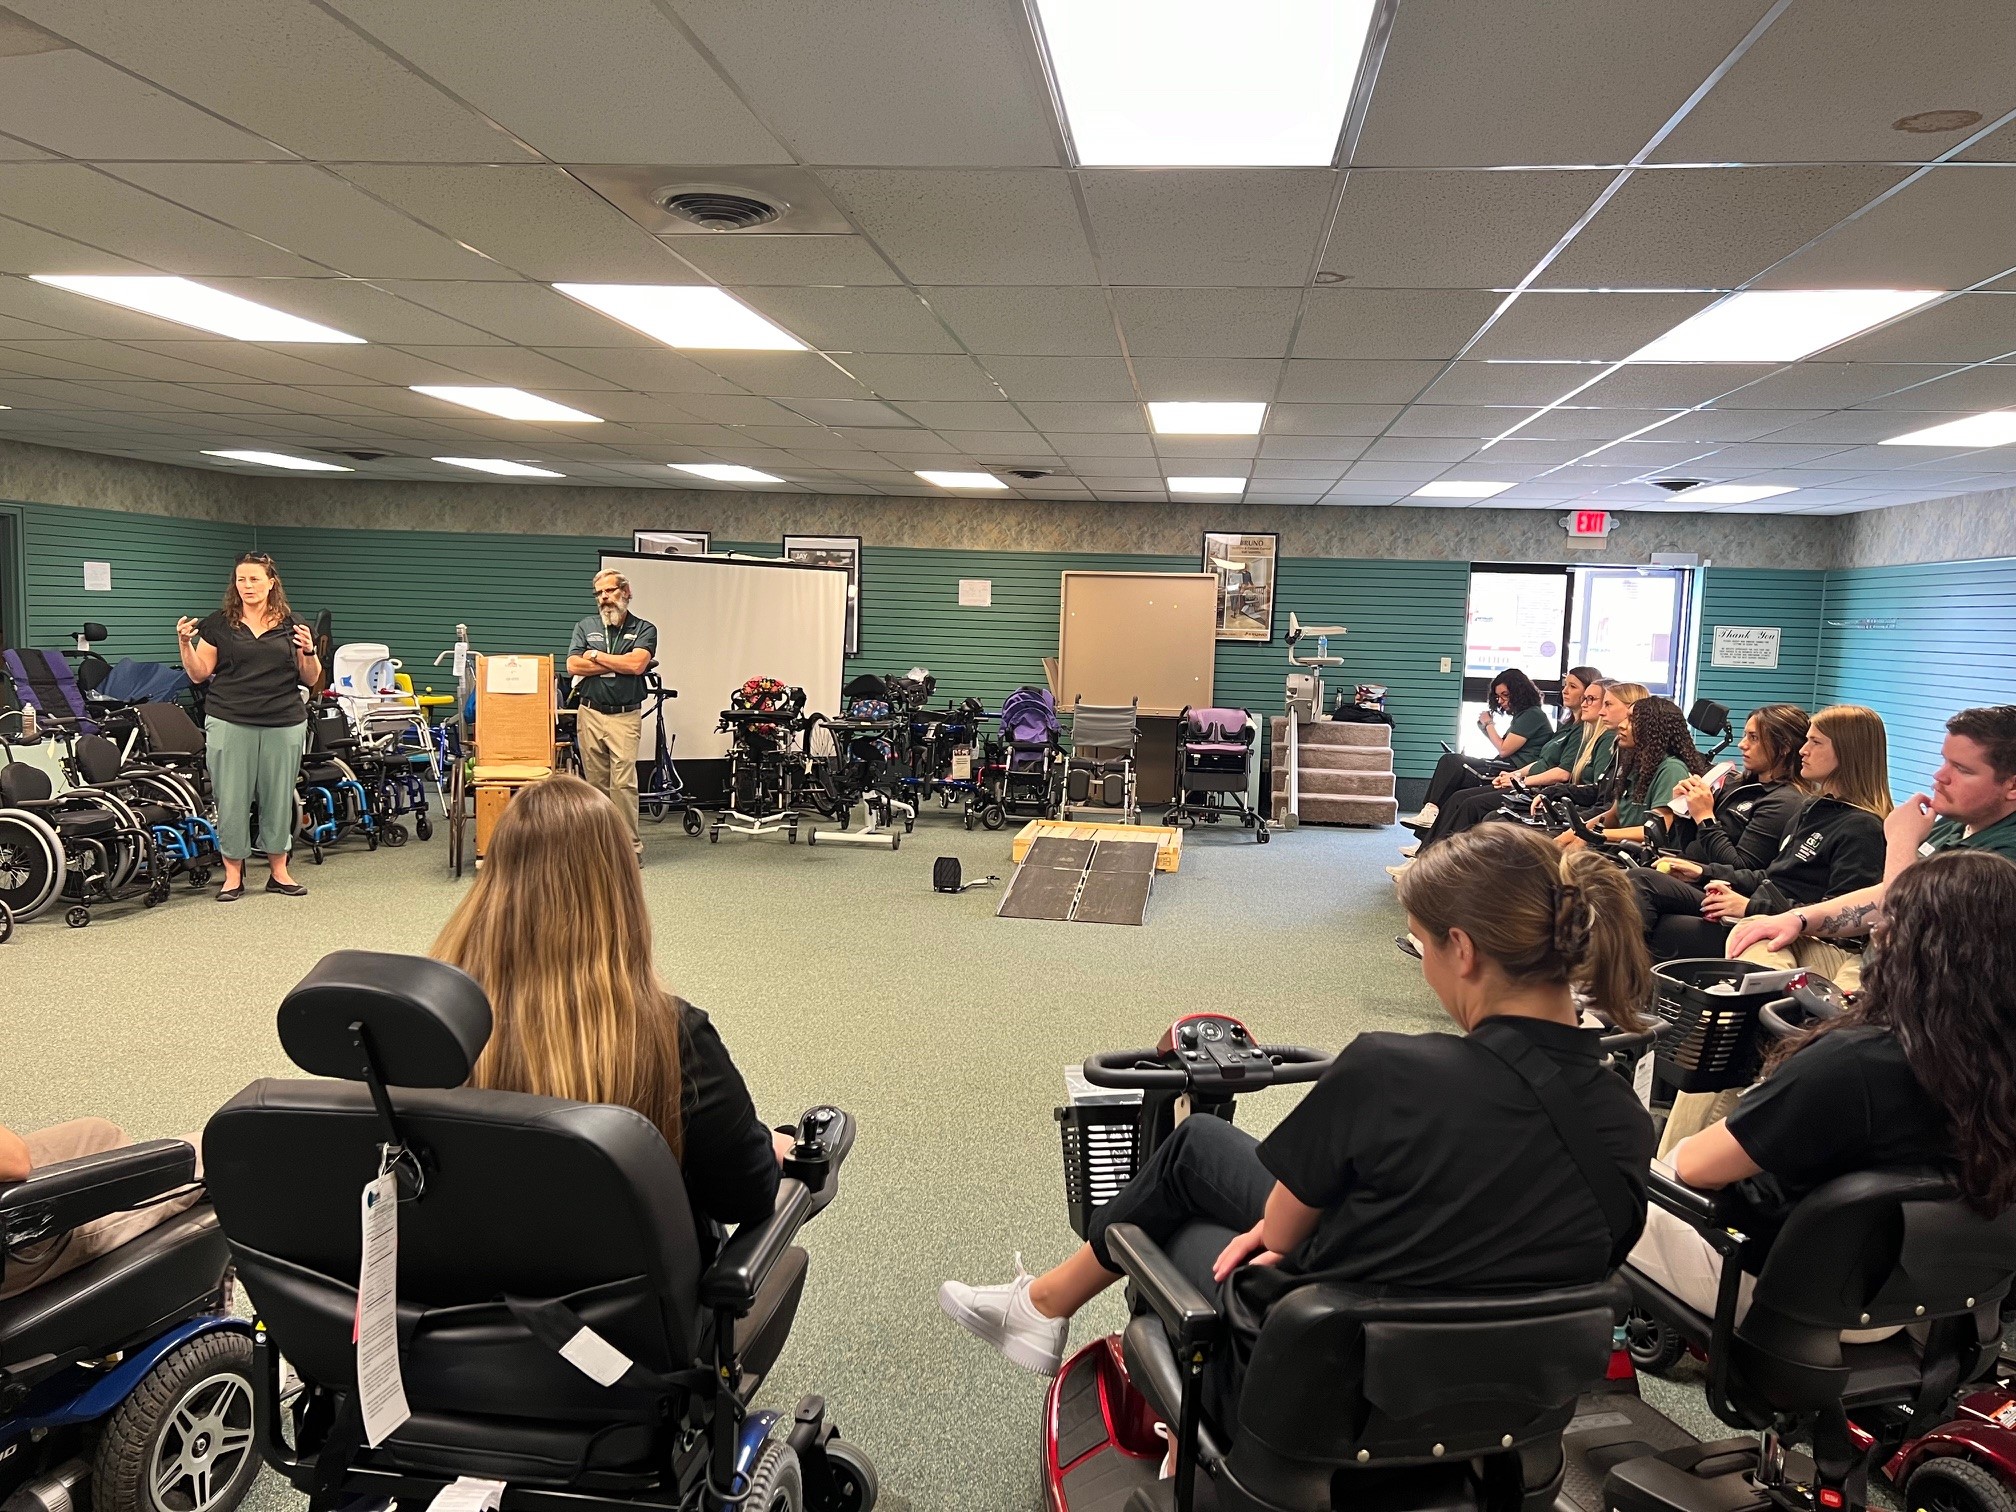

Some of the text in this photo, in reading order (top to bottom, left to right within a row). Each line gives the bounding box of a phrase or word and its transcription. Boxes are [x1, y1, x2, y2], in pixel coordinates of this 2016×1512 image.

[1577, 512, 1606, 532] EXIT
[1718, 629, 1775, 639] Thank You
